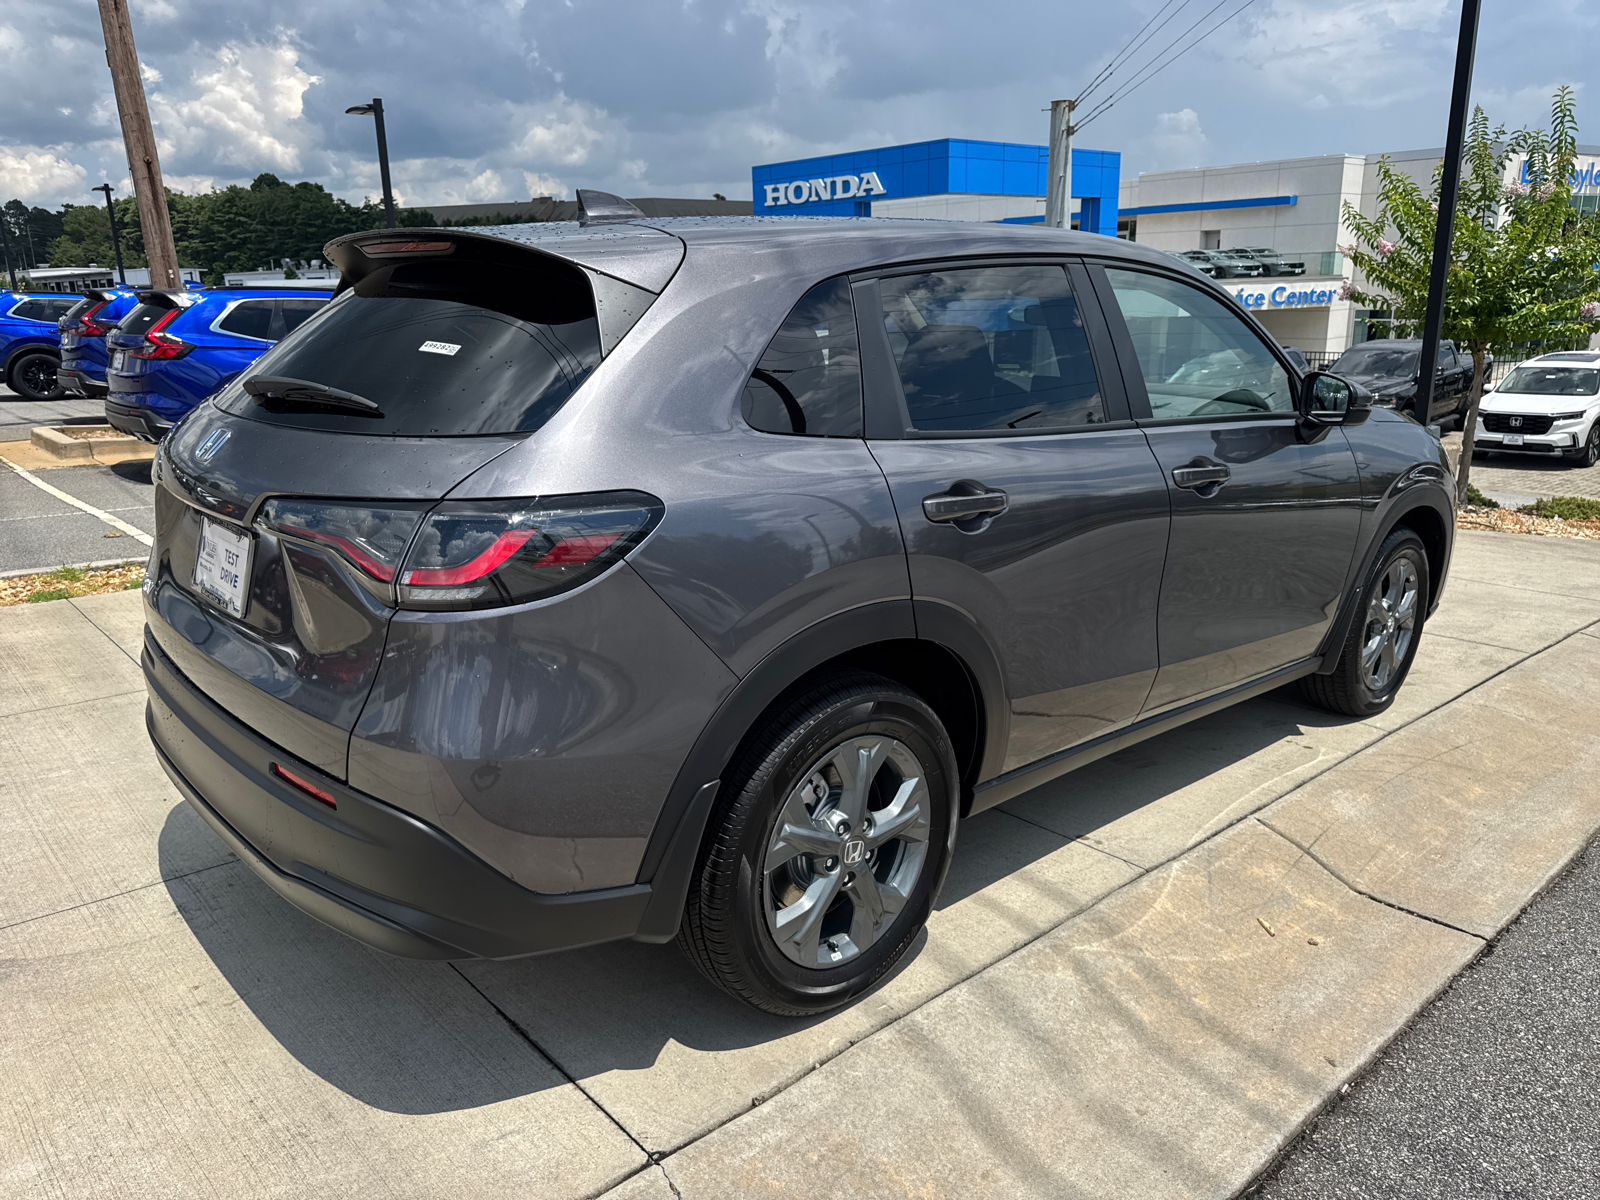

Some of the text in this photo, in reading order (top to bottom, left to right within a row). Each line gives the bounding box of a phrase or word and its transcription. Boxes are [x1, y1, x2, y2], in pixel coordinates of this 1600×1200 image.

[764, 172, 887, 207] HONDA
[1271, 286, 1337, 306] Center
[225, 548, 239, 567] TEST
[220, 567, 239, 588] DRIVE
